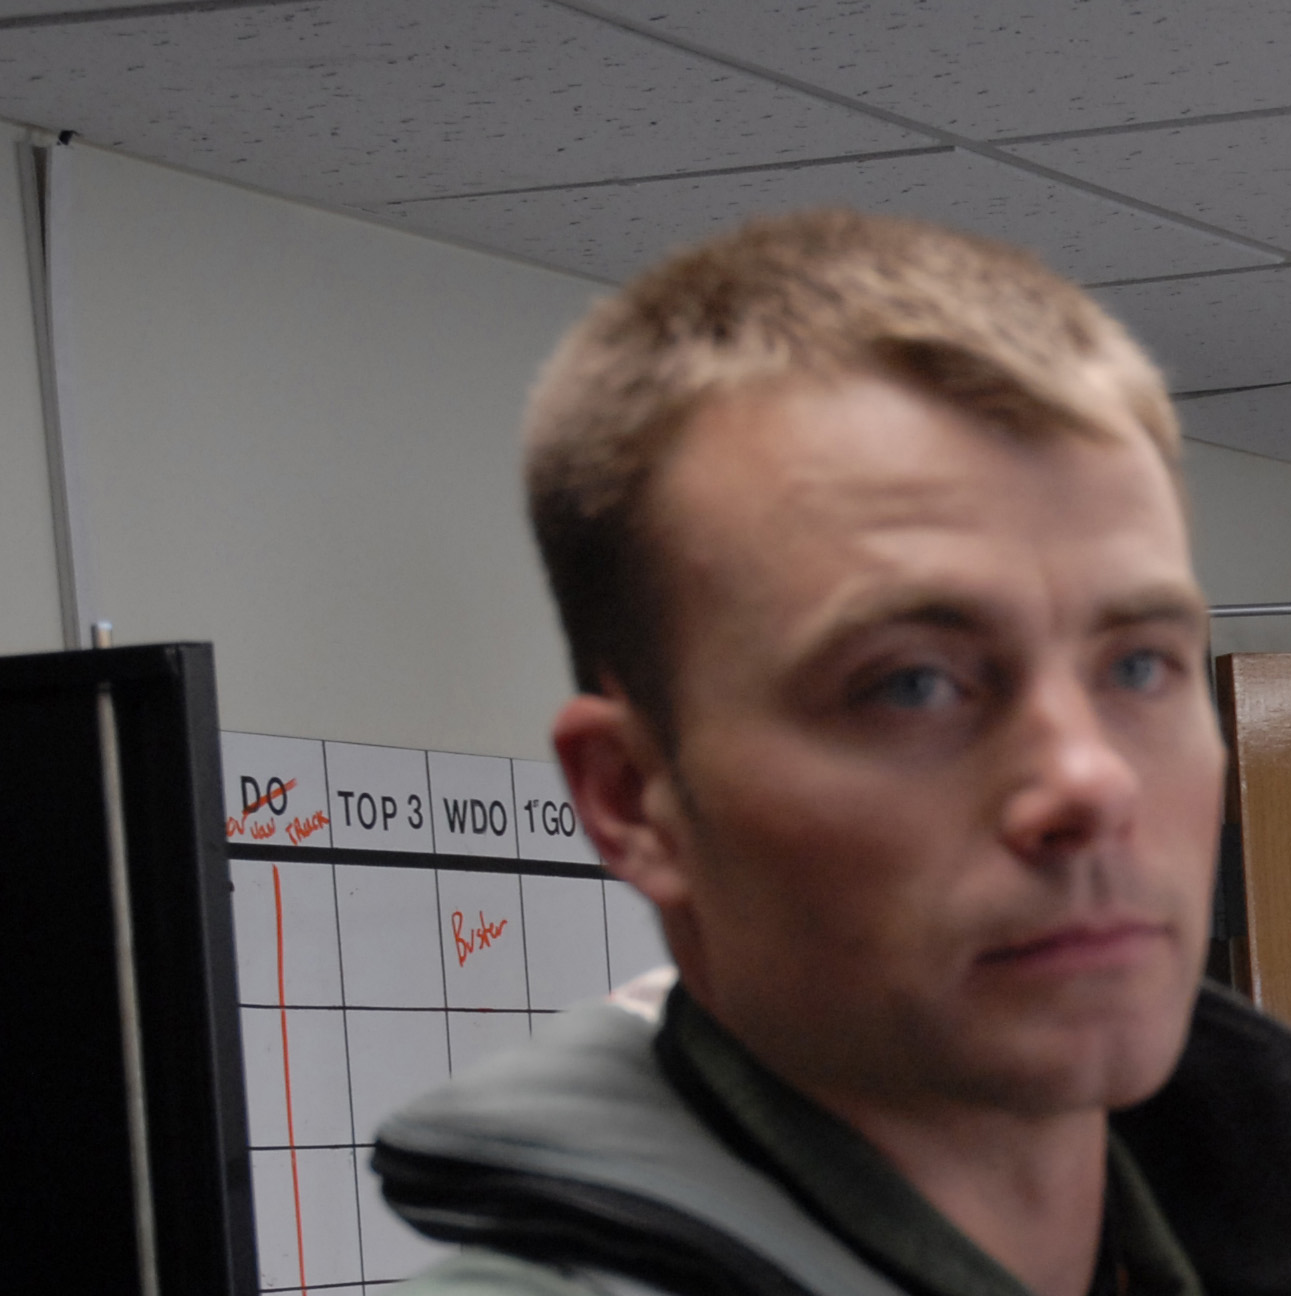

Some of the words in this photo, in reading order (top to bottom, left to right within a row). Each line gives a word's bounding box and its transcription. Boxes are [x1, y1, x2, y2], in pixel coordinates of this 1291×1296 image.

[240, 775, 288, 816] DO
[337, 790, 398, 831] TOP
[407, 794, 424, 830] 3
[443, 797, 507, 837] WDO
[542, 800, 576, 837] GO
